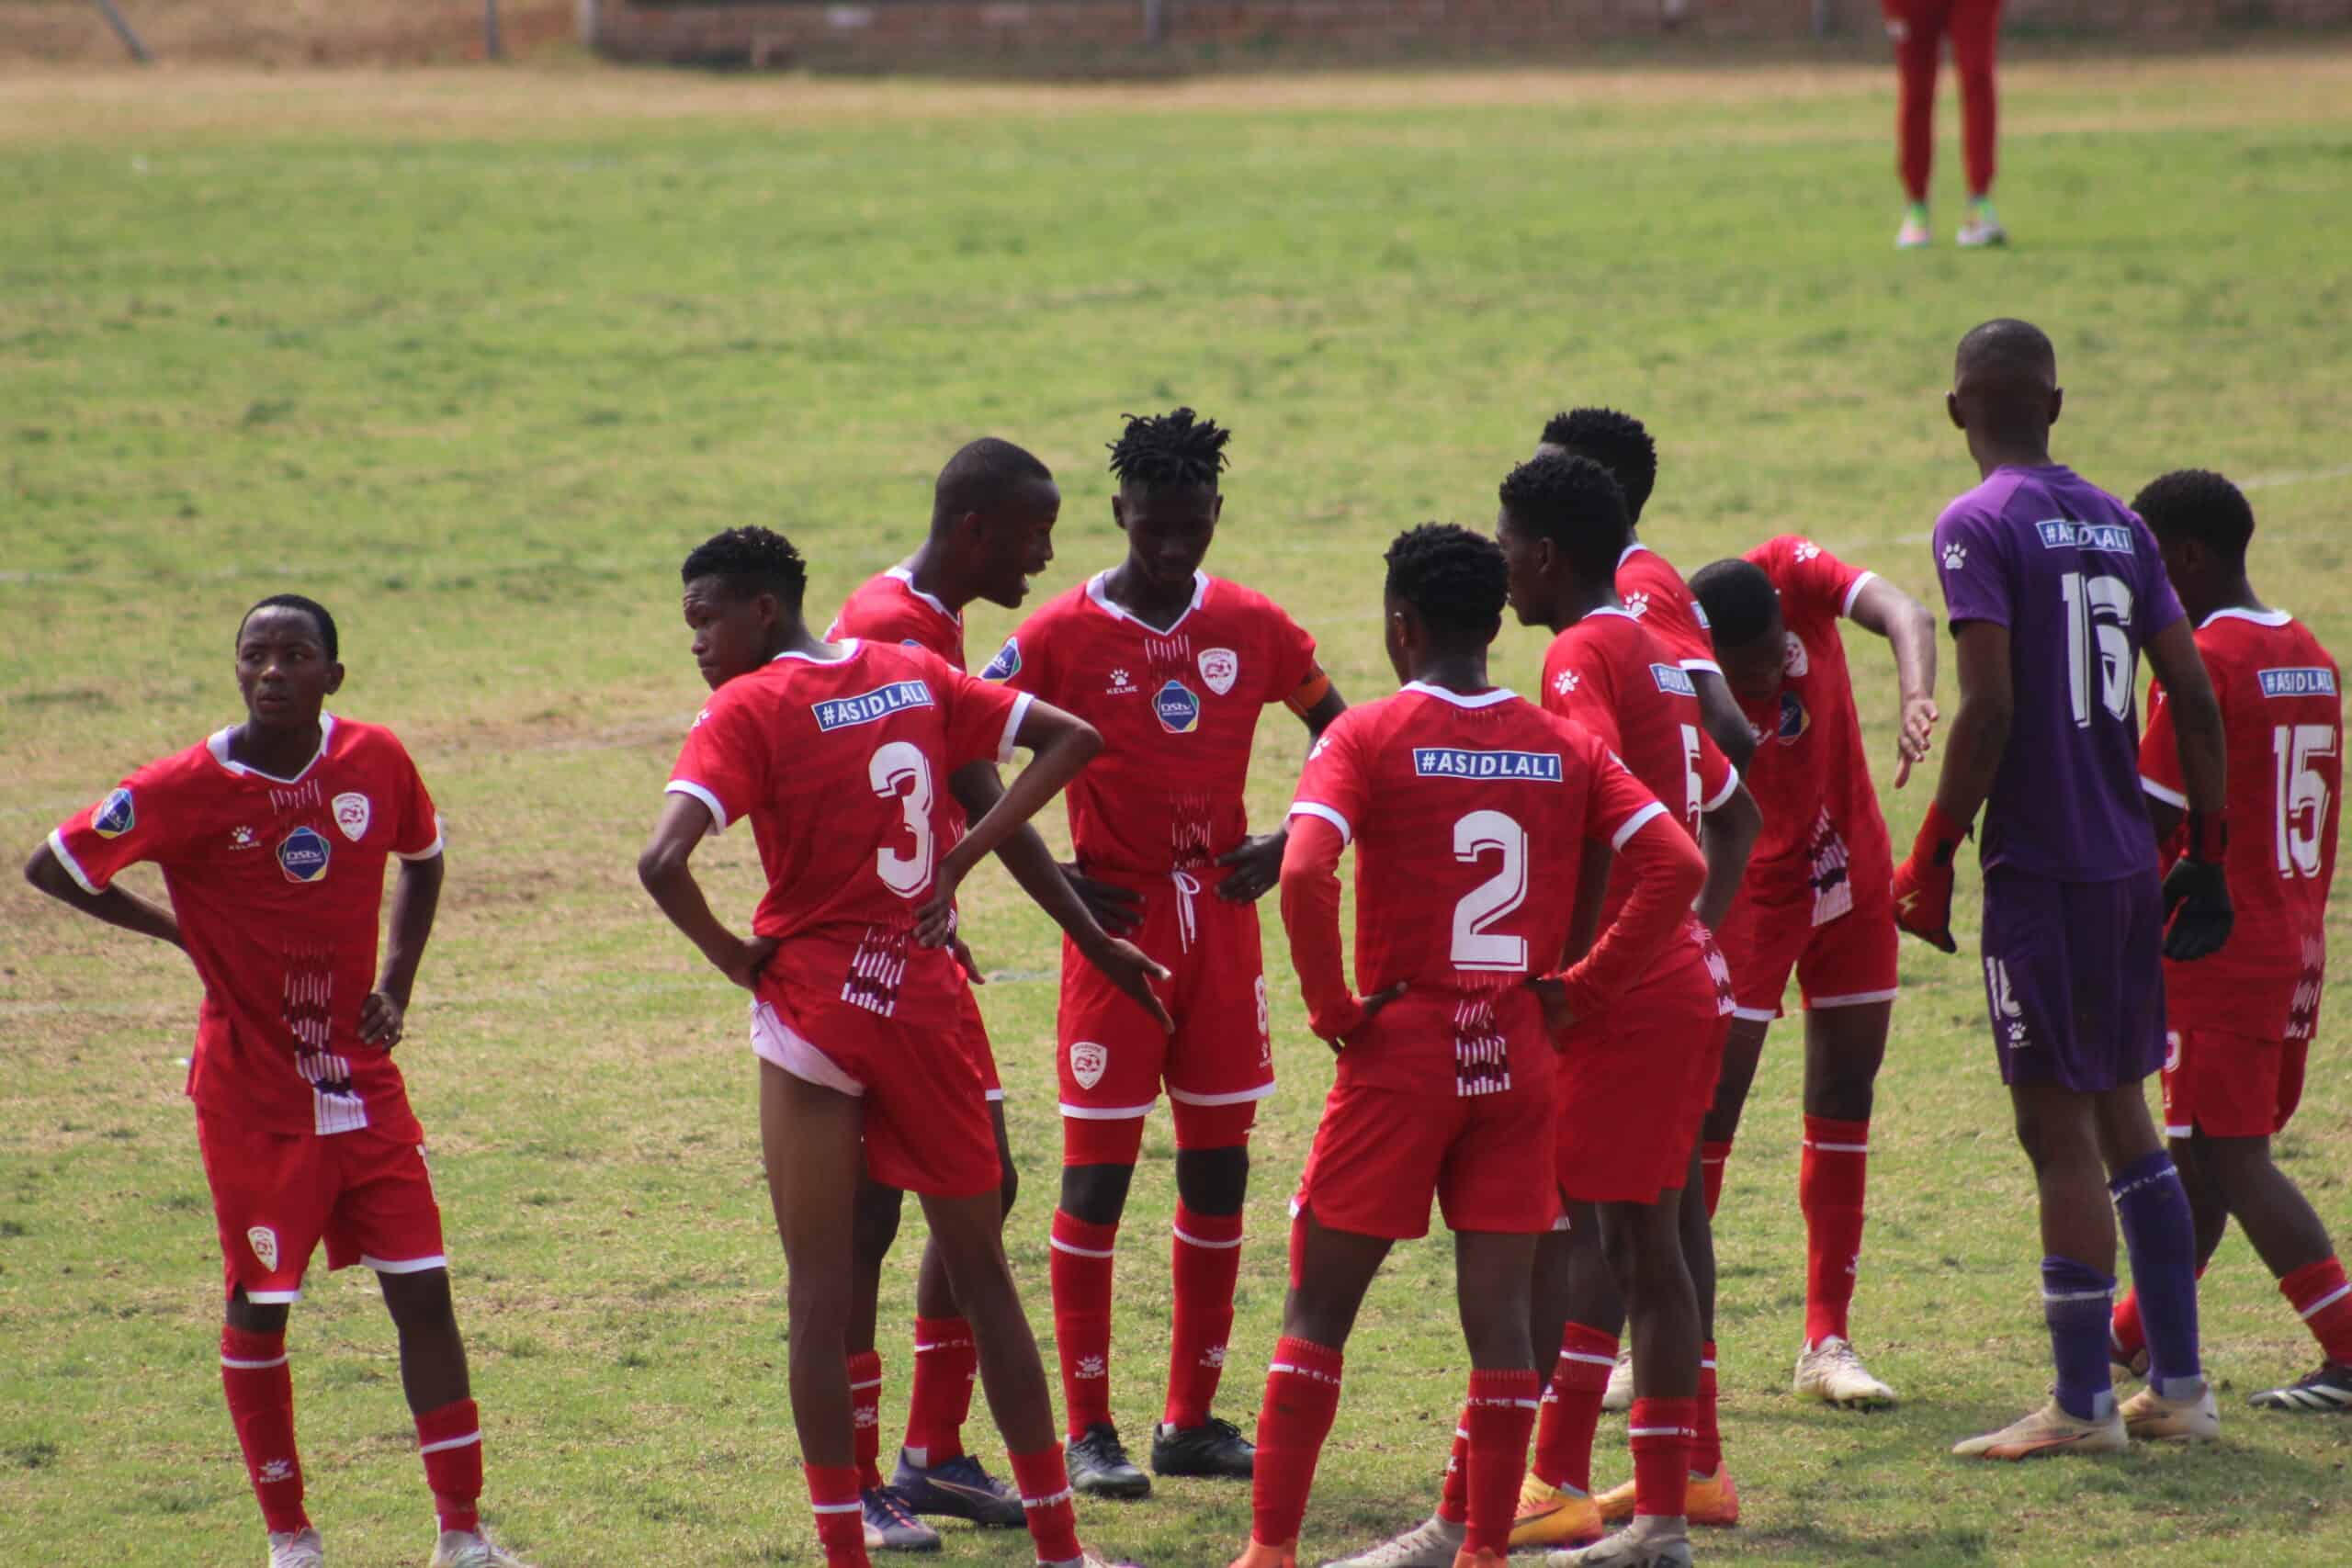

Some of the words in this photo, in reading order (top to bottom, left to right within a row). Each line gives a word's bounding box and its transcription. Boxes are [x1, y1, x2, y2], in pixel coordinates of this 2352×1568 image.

[823, 685, 928, 726] #ASIDLALI
[1106, 686, 1138, 695] KELME
[1422, 752, 1555, 776] #ASIDLALI
[2274, 724, 2336, 879] 15
[868, 741, 934, 898] 3
[1450, 810, 1528, 972] 2
